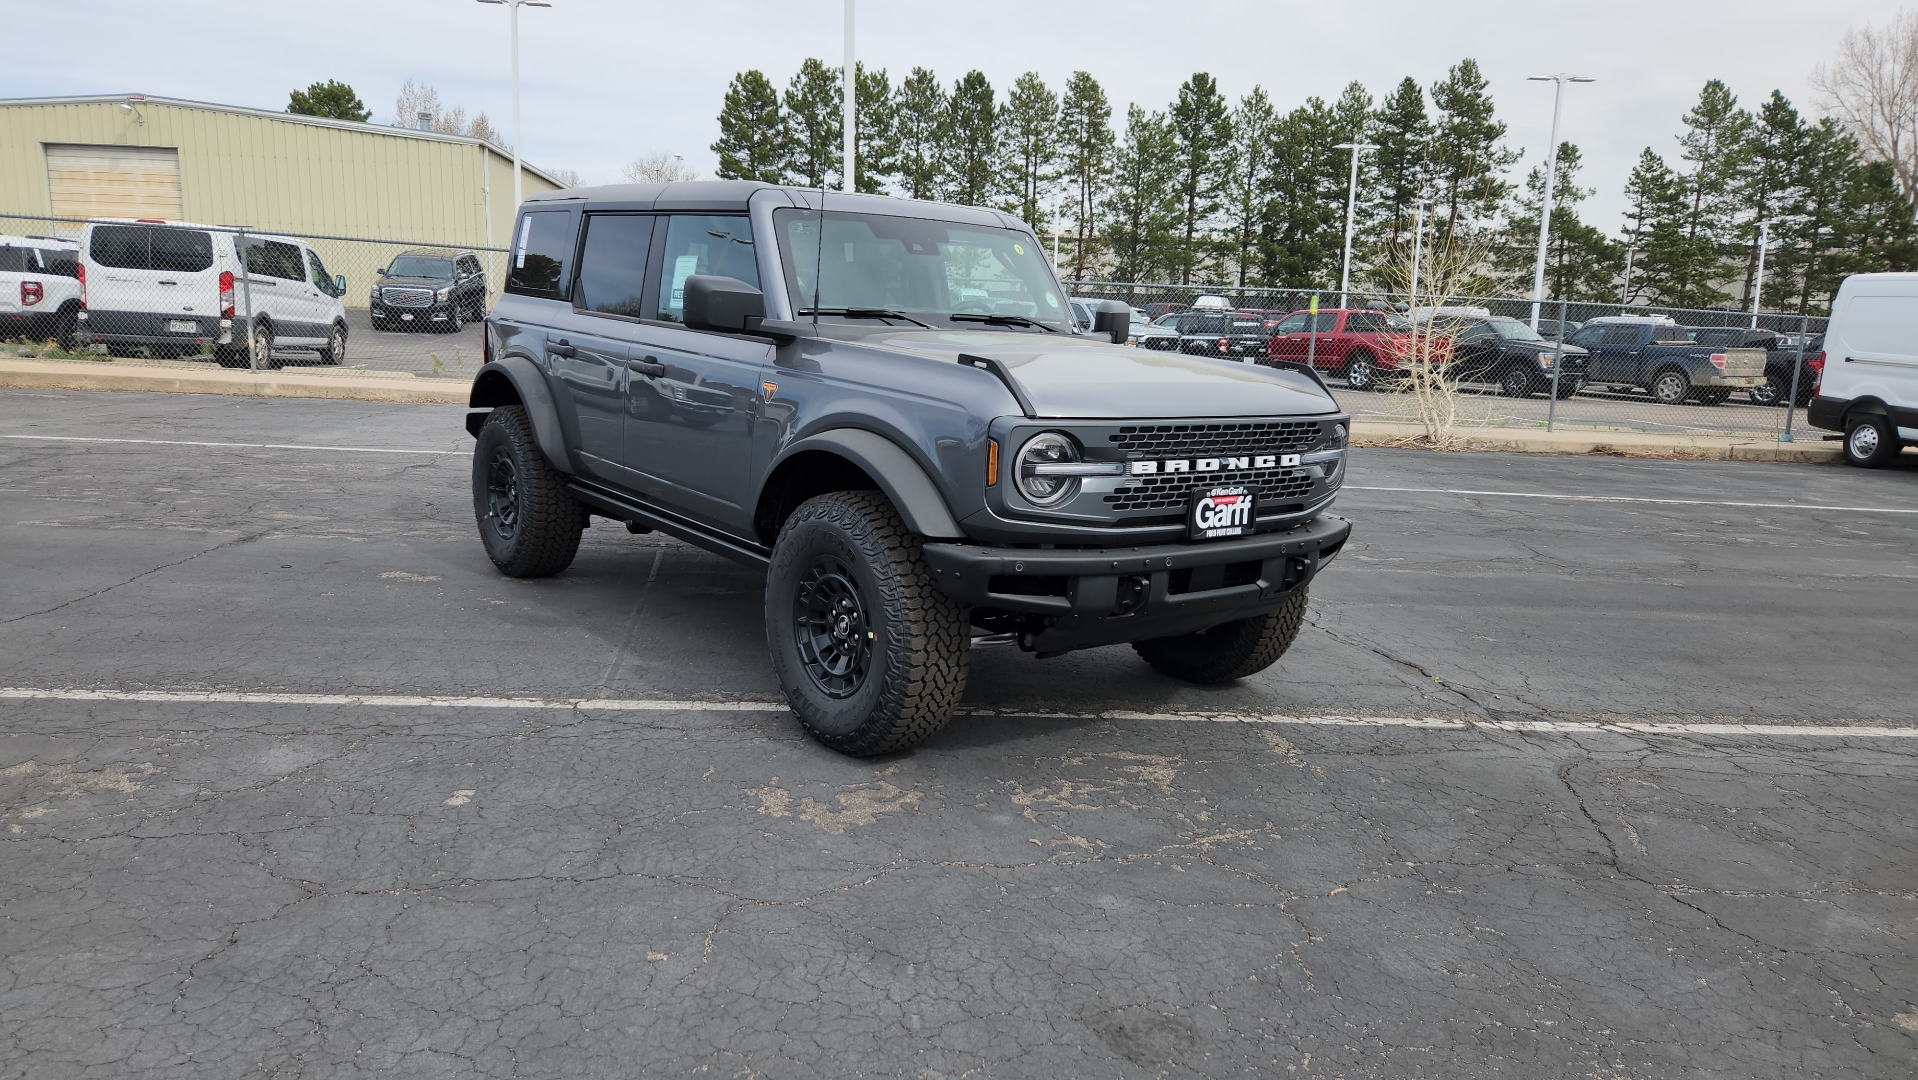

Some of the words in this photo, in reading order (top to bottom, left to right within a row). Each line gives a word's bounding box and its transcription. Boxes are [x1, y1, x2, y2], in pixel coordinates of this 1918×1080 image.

[1131, 453, 1300, 475] BRONCO
[1216, 487, 1229, 496] Ken
[1228, 486, 1244, 495] Garff
[1195, 495, 1252, 529] Garff
